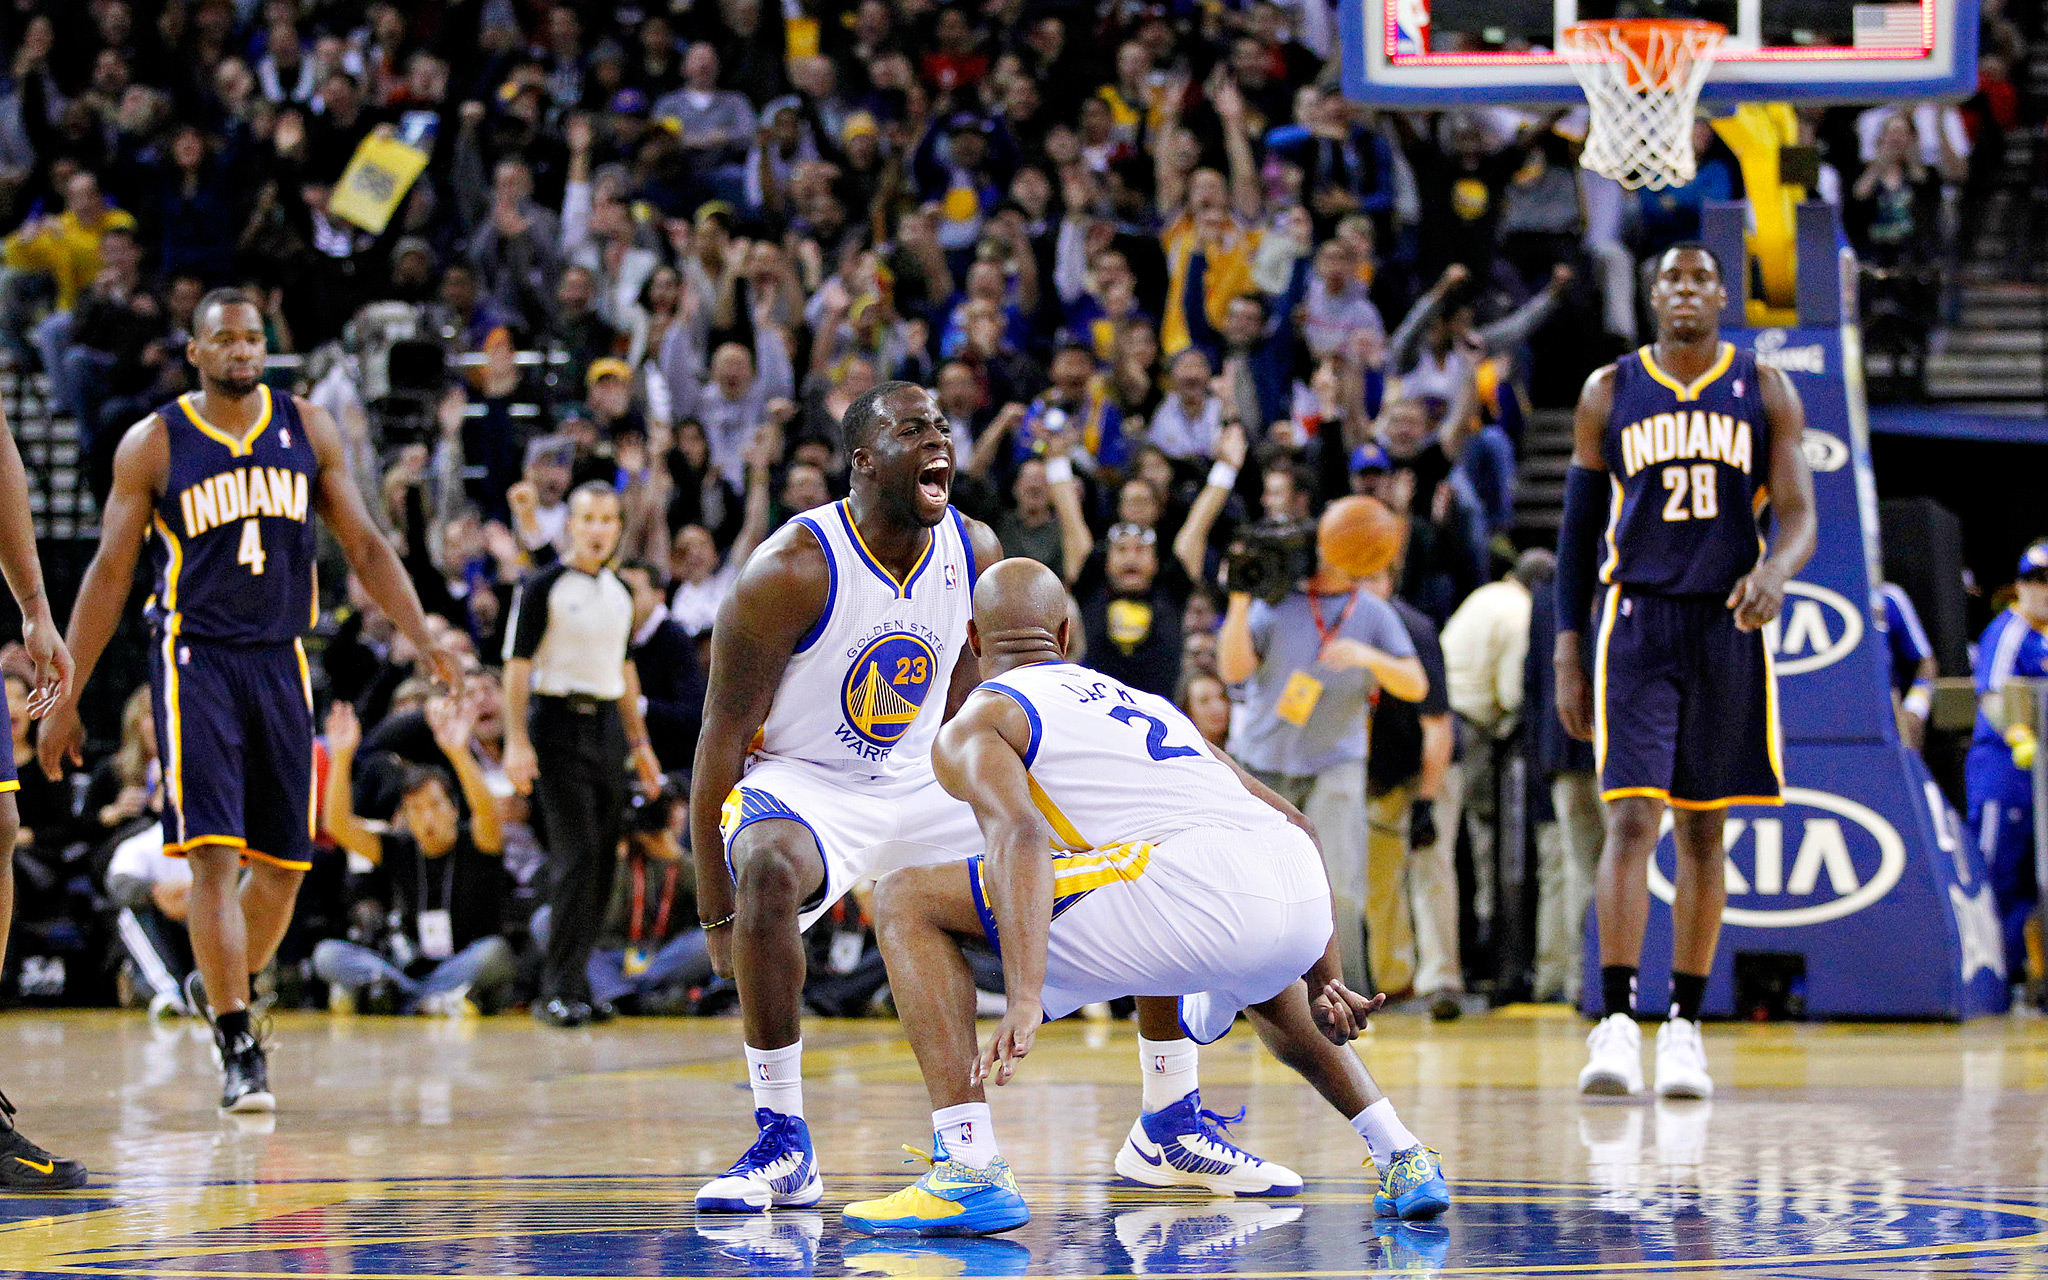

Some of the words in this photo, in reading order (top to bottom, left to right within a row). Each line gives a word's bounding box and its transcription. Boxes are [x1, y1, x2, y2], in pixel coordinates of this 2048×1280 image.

[1621, 410, 1753, 477] INDIANA
[180, 466, 309, 538] INDIANA
[1662, 463, 1719, 522] 28
[237, 518, 267, 575] 4
[846, 620, 904, 658] GOLDEN
[910, 622, 945, 655] STATE
[1762, 600, 1833, 655] IA
[892, 656, 928, 685] 23
[834, 722, 893, 762] WARR
[1106, 705, 1205, 761] 2
